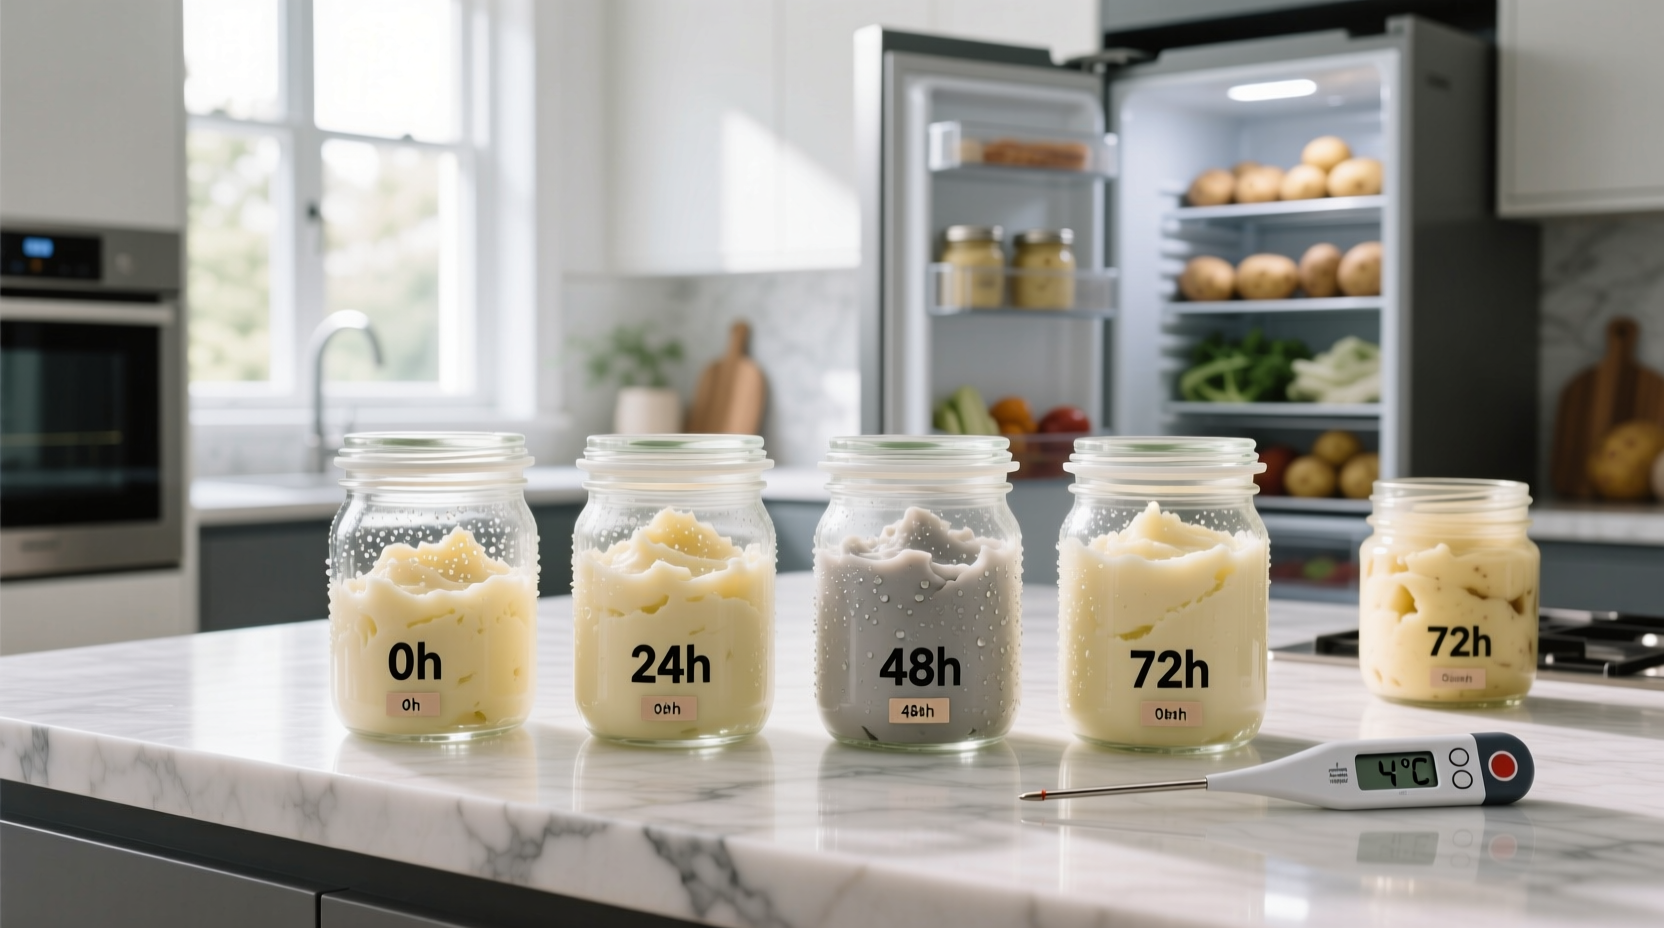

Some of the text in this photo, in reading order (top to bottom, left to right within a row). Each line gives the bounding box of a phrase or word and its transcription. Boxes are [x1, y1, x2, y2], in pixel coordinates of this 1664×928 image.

[388, 641, 442, 681] 0h
[1428, 625, 1491, 658] 72h
[631, 644, 711, 684] 24h
[879, 646, 962, 688] 48h
[1130, 649, 1209, 689] 72h
